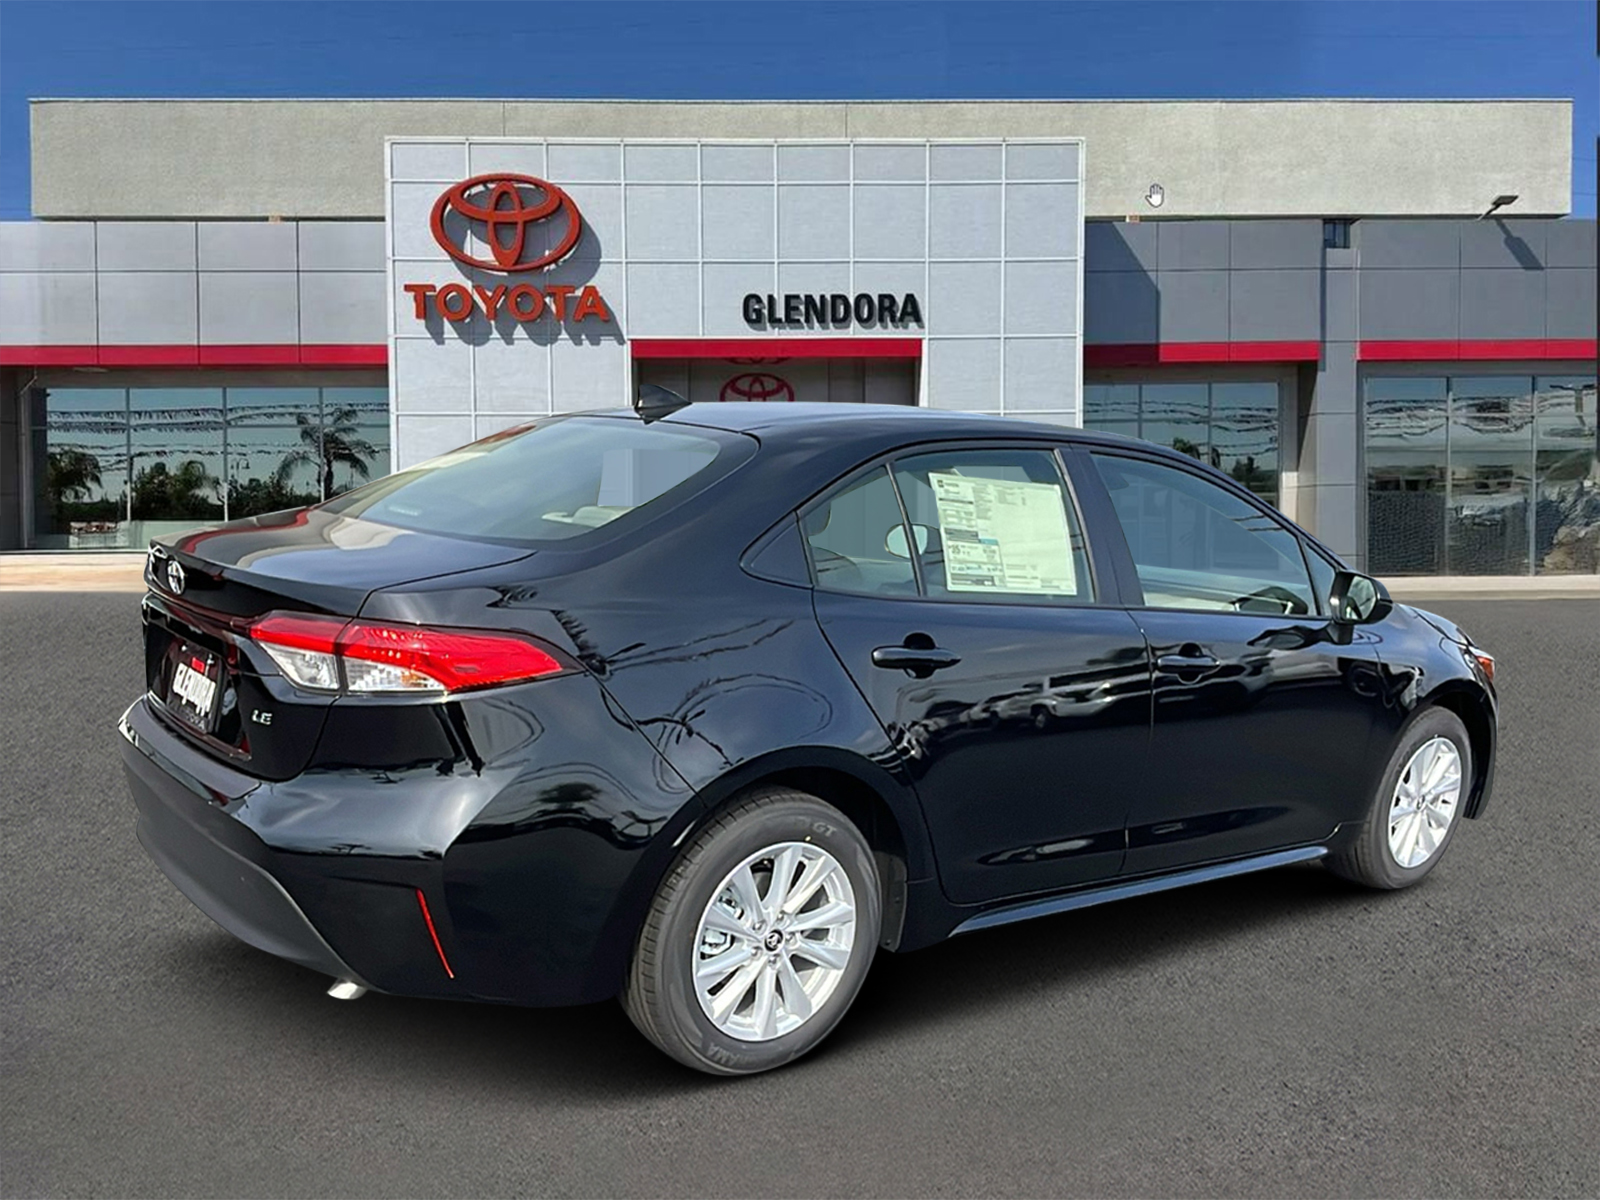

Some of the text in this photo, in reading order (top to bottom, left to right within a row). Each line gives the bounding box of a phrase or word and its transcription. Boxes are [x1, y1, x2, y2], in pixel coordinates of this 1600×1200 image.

[403, 283, 610, 322] TOYOTA
[742, 293, 923, 325] GLENDORA
[252, 709, 273, 725] LE
